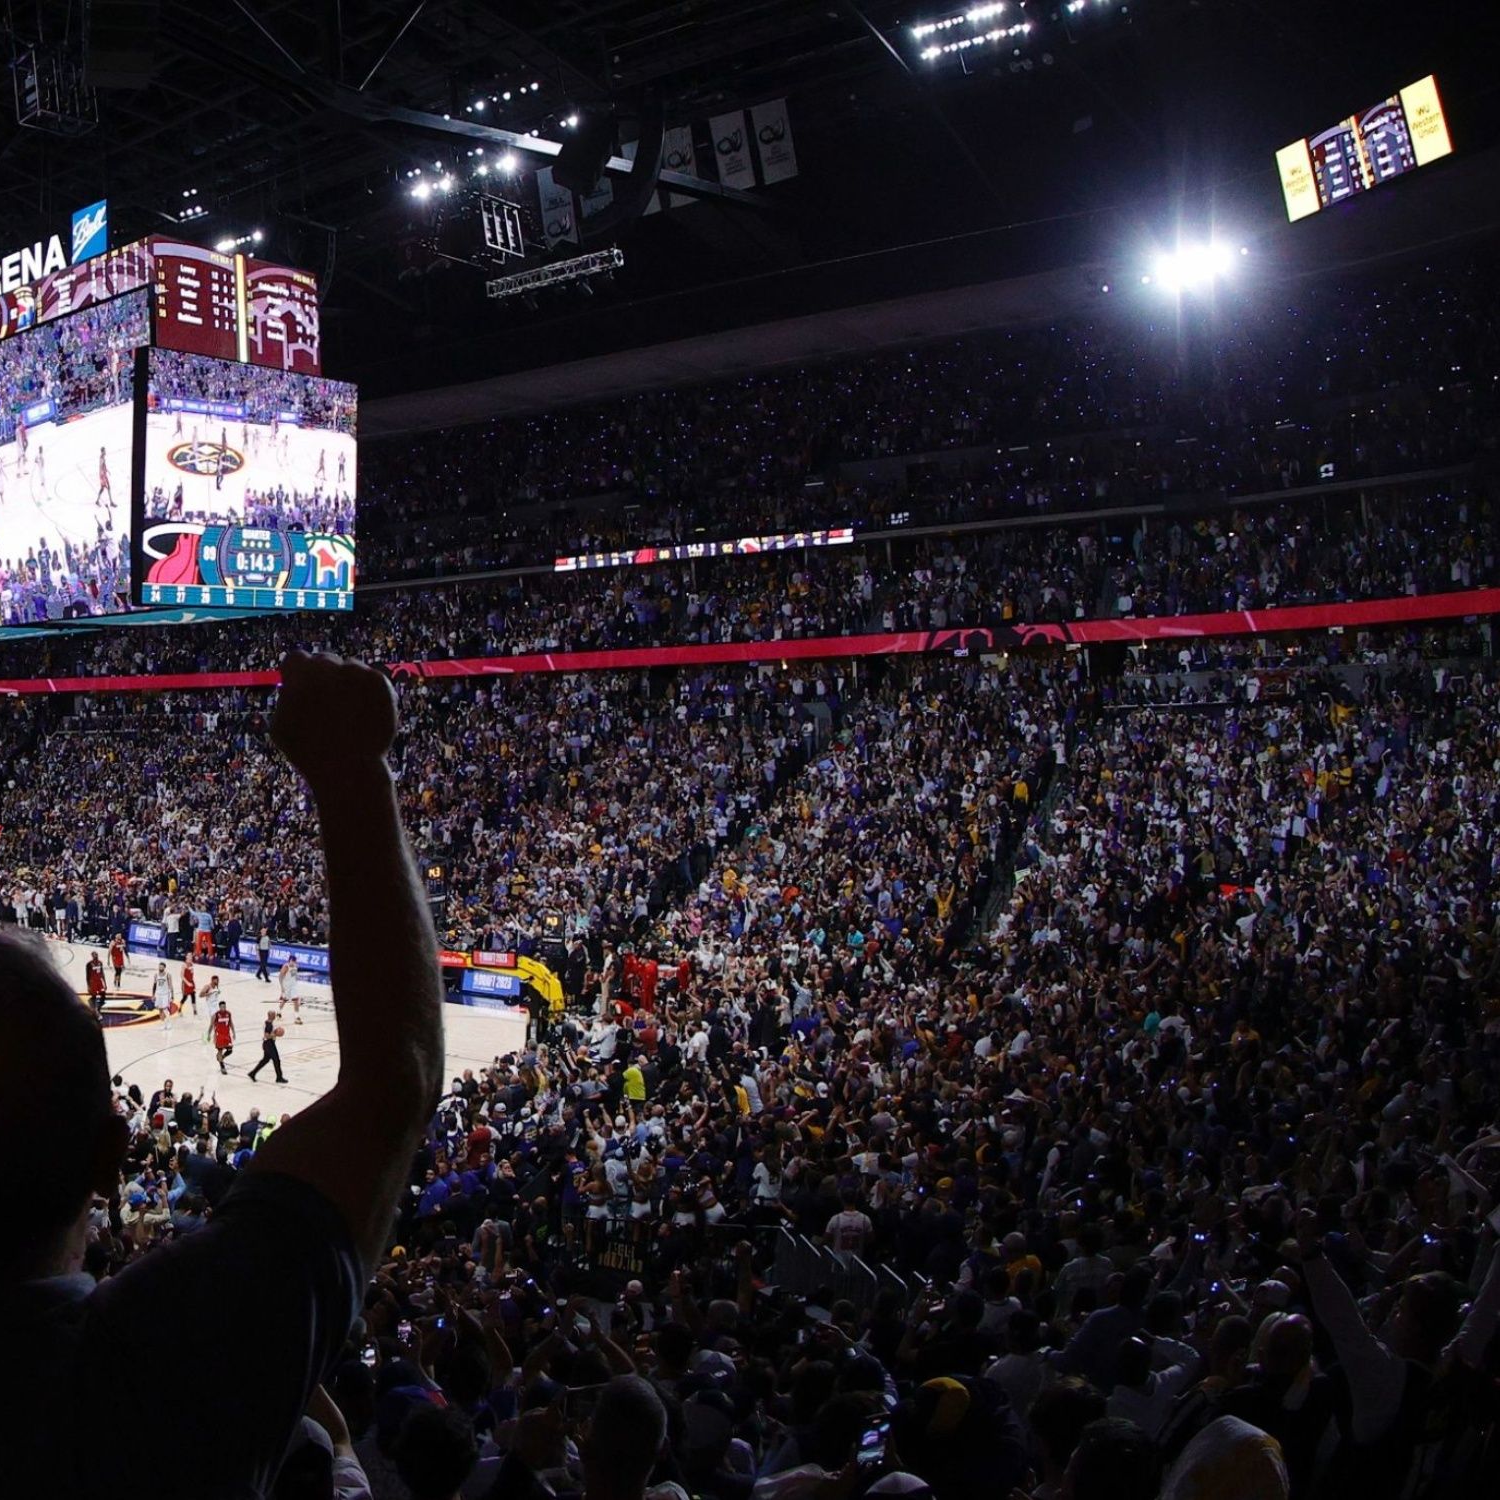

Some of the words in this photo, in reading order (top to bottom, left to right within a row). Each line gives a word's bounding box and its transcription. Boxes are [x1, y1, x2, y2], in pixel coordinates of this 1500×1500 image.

[236, 552, 275, 572] 0:14.3
[294, 552, 307, 566] 92
[310, 953, 320, 966] 22
